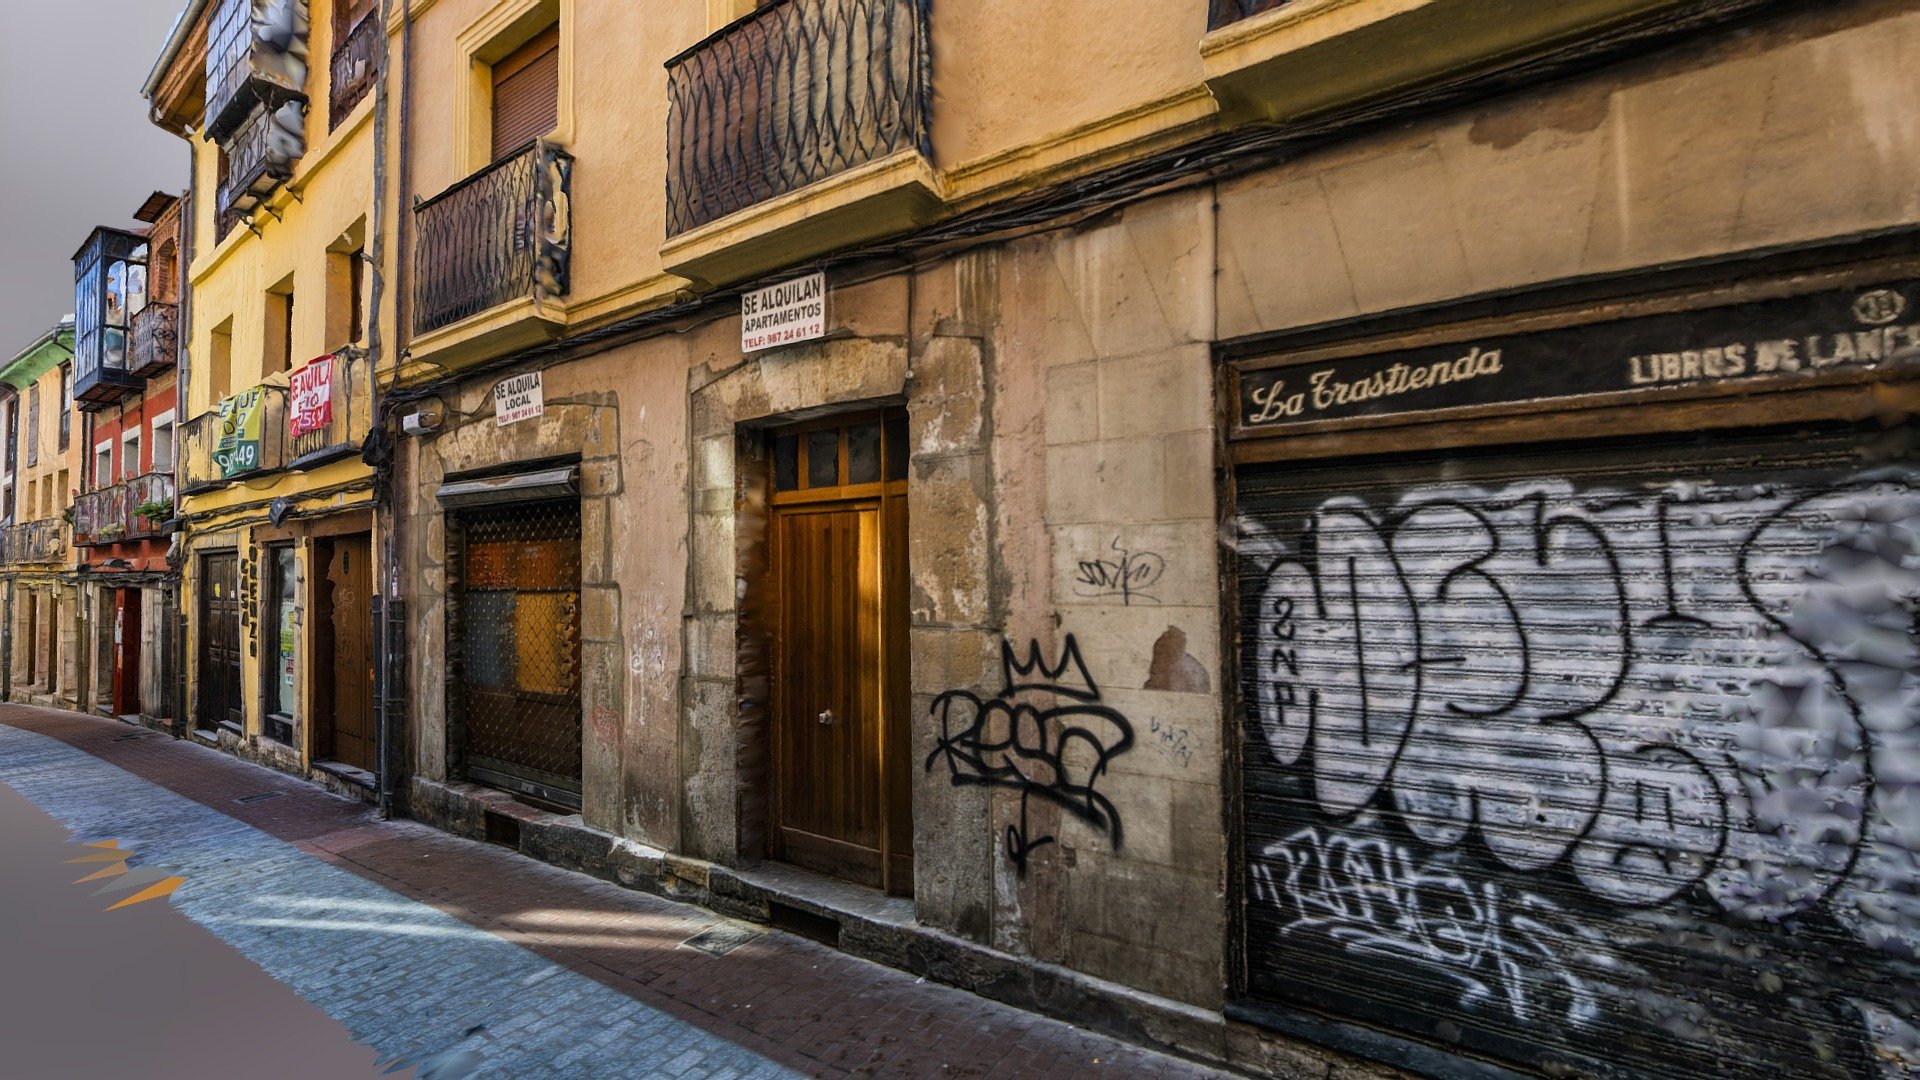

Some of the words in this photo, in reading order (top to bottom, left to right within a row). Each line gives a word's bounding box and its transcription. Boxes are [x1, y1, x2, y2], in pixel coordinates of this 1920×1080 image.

[743, 295, 757, 316] SE
[760, 277, 821, 312] ALQUILAN
[744, 302, 821, 333] APARTAMENTOS
[744, 336, 766, 349] TELF:
[767, 332, 781, 344] 987
[783, 329, 794, 340] 24
[796, 327, 806, 337] 61
[809, 323, 820, 334] 12
[1628, 342, 1747, 384] LIBROS
[495, 384, 506, 400] SE
[507, 373, 540, 397] ALQUILA
[1249, 380, 1305, 422] La
[1310, 346, 1504, 410] Trastienda
[505, 394, 531, 410] LOCAL
